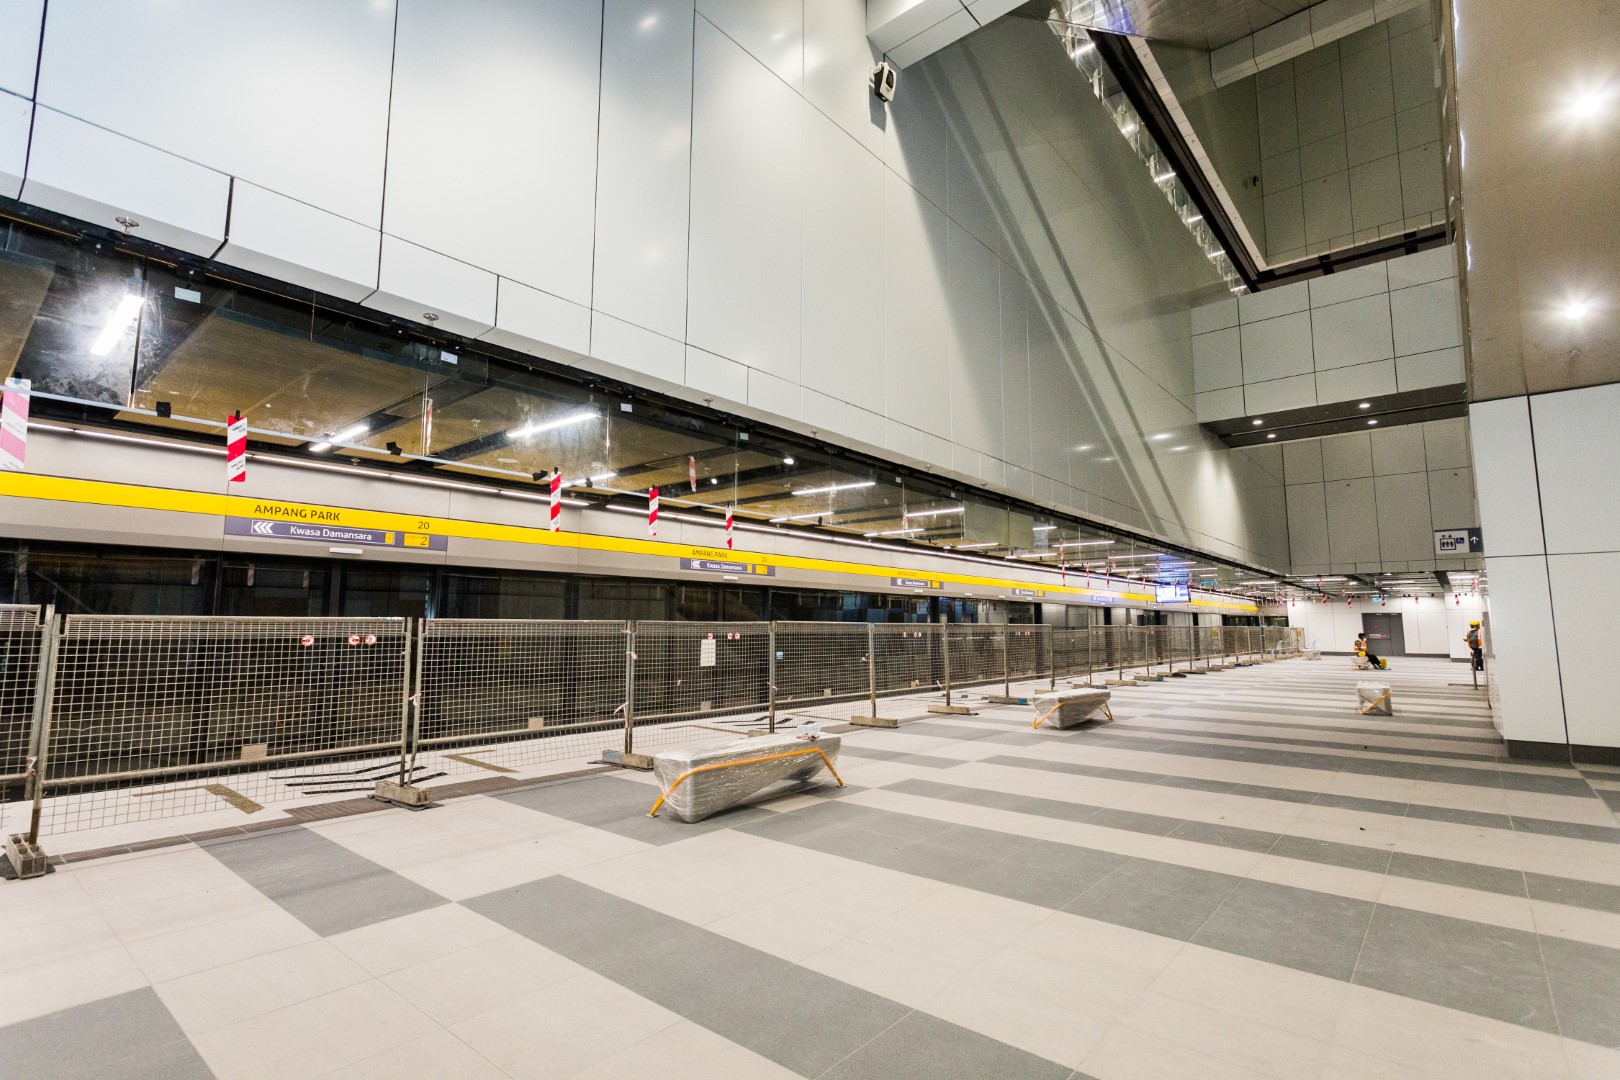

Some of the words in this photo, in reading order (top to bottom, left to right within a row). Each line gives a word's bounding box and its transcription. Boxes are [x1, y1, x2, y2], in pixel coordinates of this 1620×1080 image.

[254, 504, 307, 518] AMPANG
[310, 510, 341, 521] PARK
[418, 521, 430, 529] 20
[290, 526, 320, 537] Kwasa
[322, 528, 372, 540] Damansara
[420, 536, 428, 545] 2
